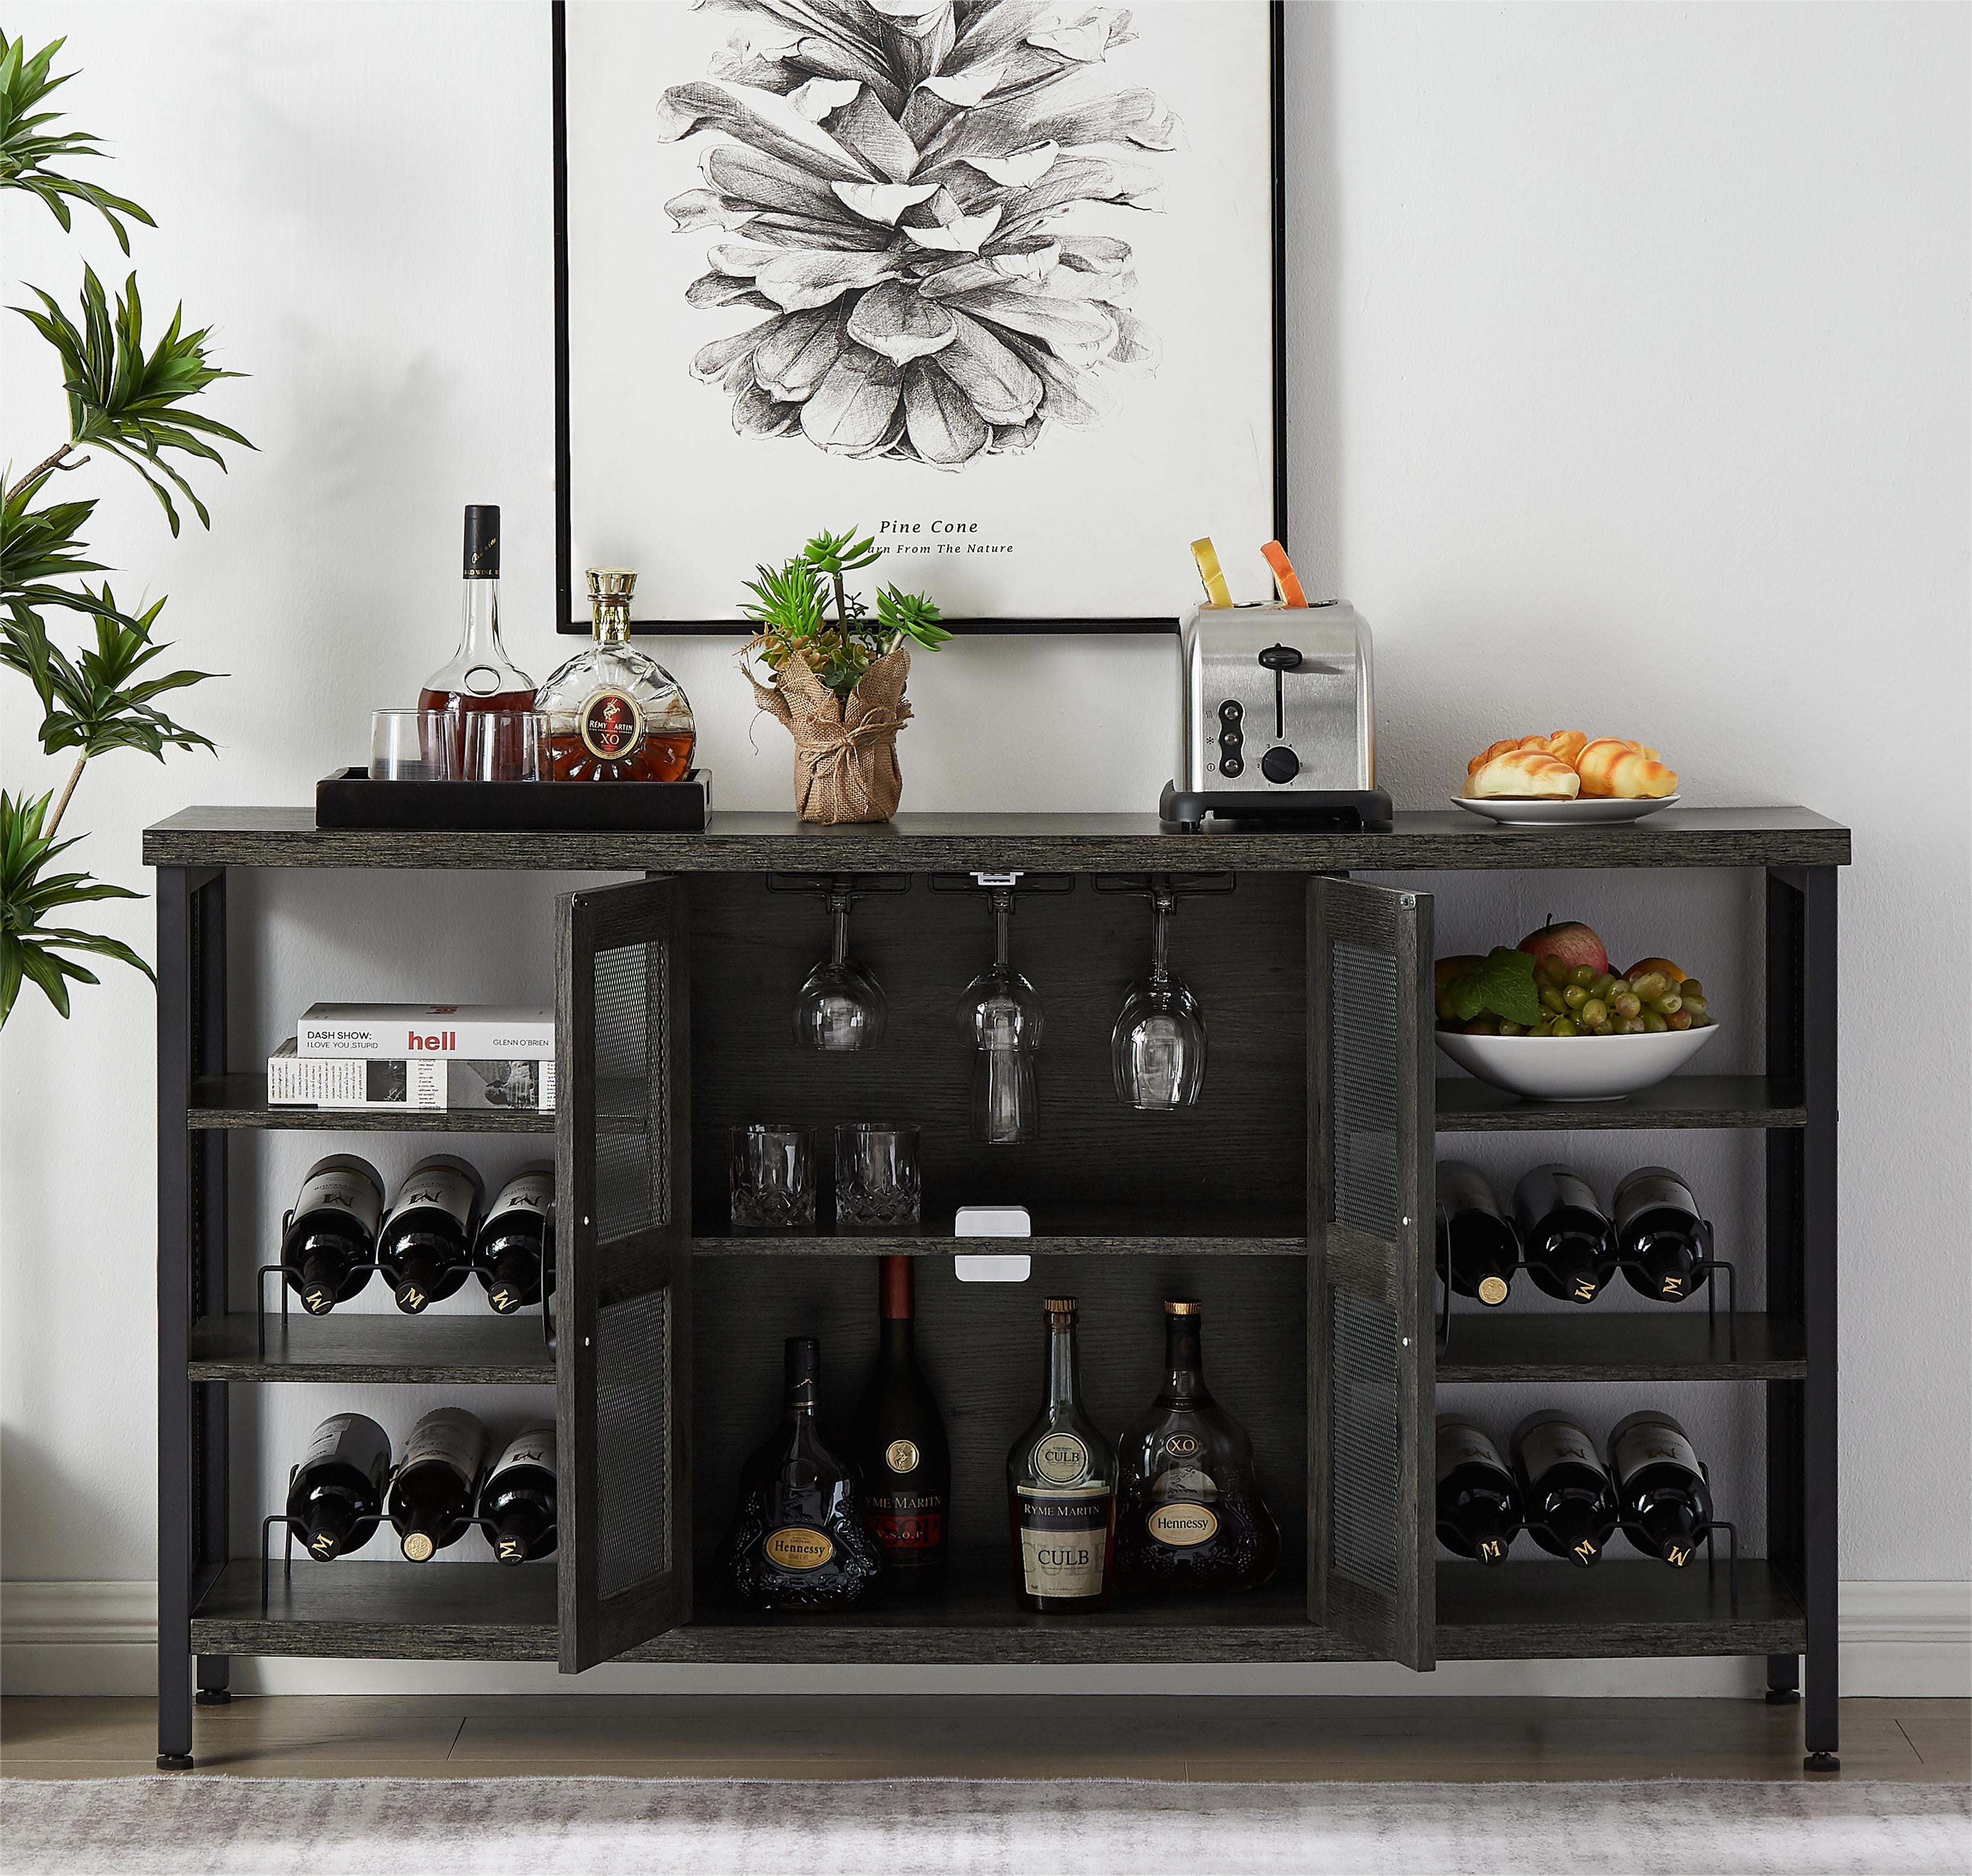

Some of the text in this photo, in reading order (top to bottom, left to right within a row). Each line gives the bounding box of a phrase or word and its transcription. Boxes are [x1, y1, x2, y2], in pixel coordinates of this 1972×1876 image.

[879, 520, 979, 533] Pine Cone
[897, 545, 930, 554] From
[937, 544, 961, 553] The
[967, 544, 1013, 553] Nature
[600, 733, 619, 745] XO
[337, 1031, 372, 1040] SHOW:
[408, 1031, 456, 1051] hell
[1045, 1451, 1080, 1462] CULB
[1024, 1503, 1100, 1516] RYME MARITN
[1157, 1517, 1209, 1530] Hennessy
[775, 1540, 825, 1558] Hennessy
[1038, 1549, 1089, 1566] CULB
